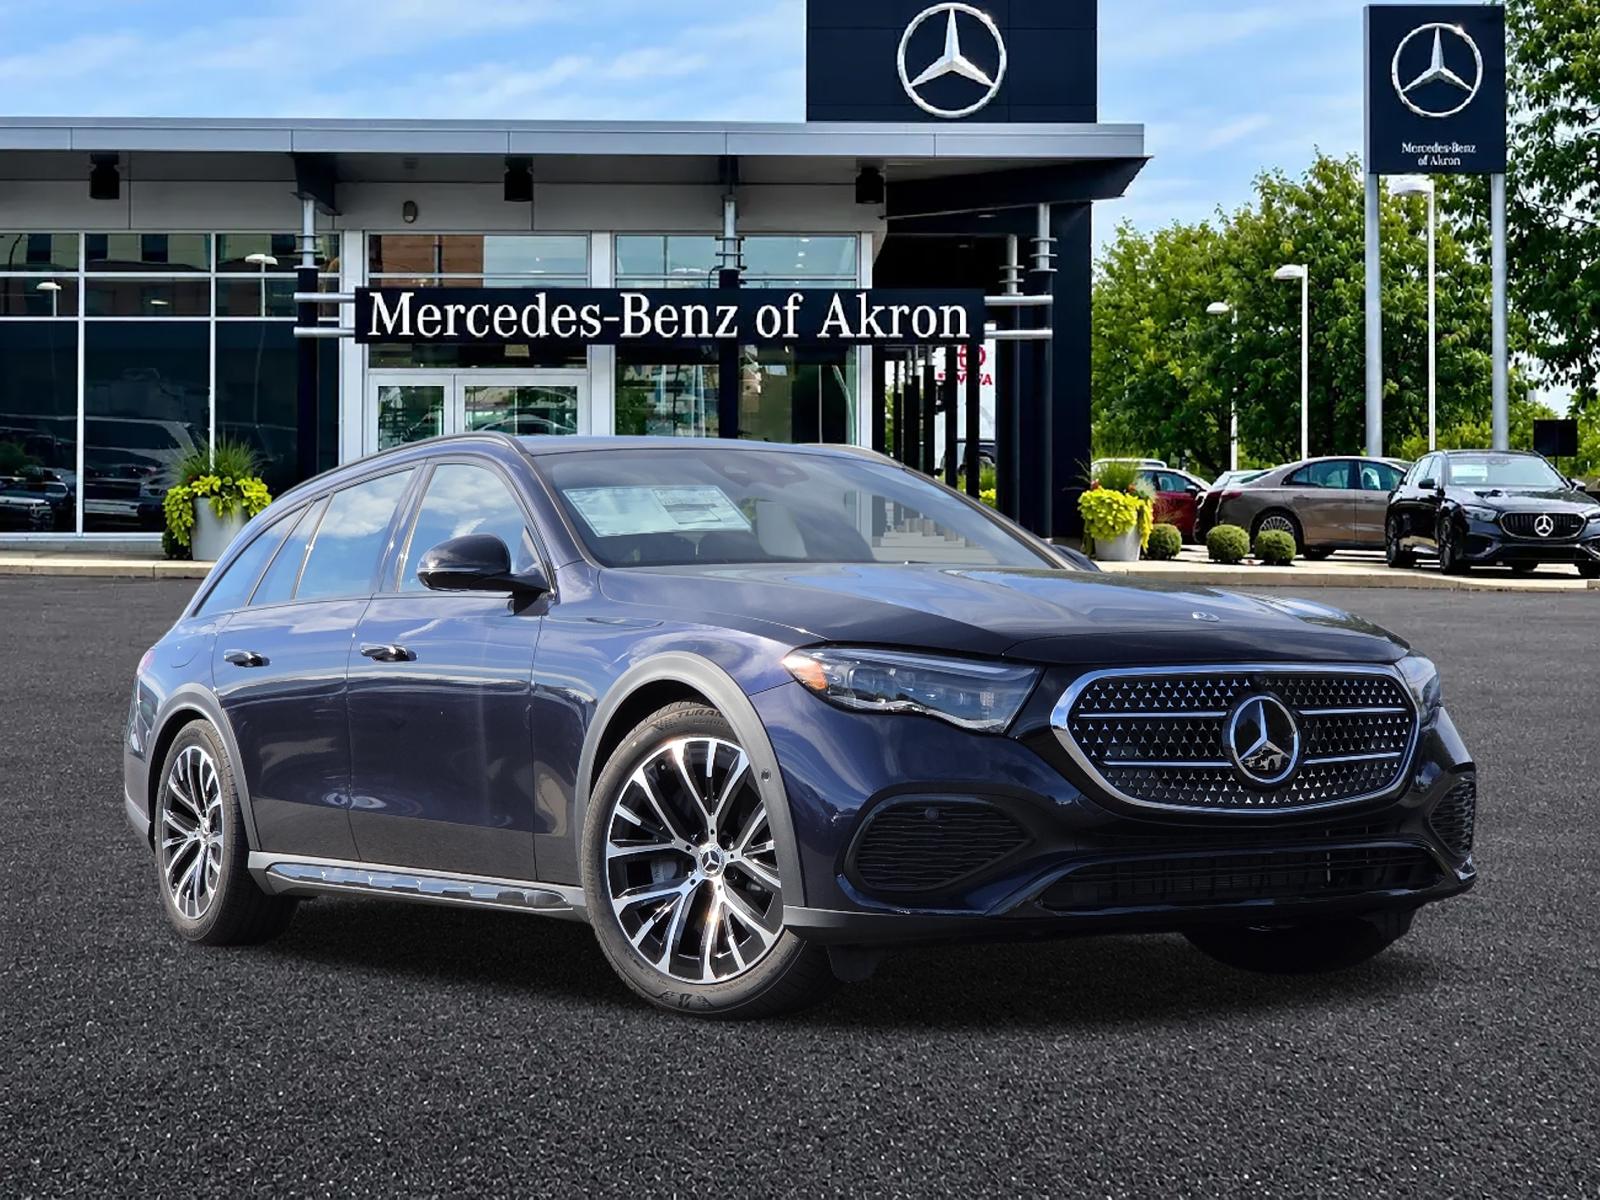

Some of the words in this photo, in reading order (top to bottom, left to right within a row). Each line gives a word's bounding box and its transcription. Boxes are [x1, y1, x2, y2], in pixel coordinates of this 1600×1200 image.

[1401, 141, 1476, 153] Mercedes-Benz
[1417, 154, 1429, 165] of
[1430, 154, 1460, 165] Akron
[367, 291, 738, 338] Mercedes-Benz
[755, 292, 804, 338] of
[816, 291, 971, 338] Akron
